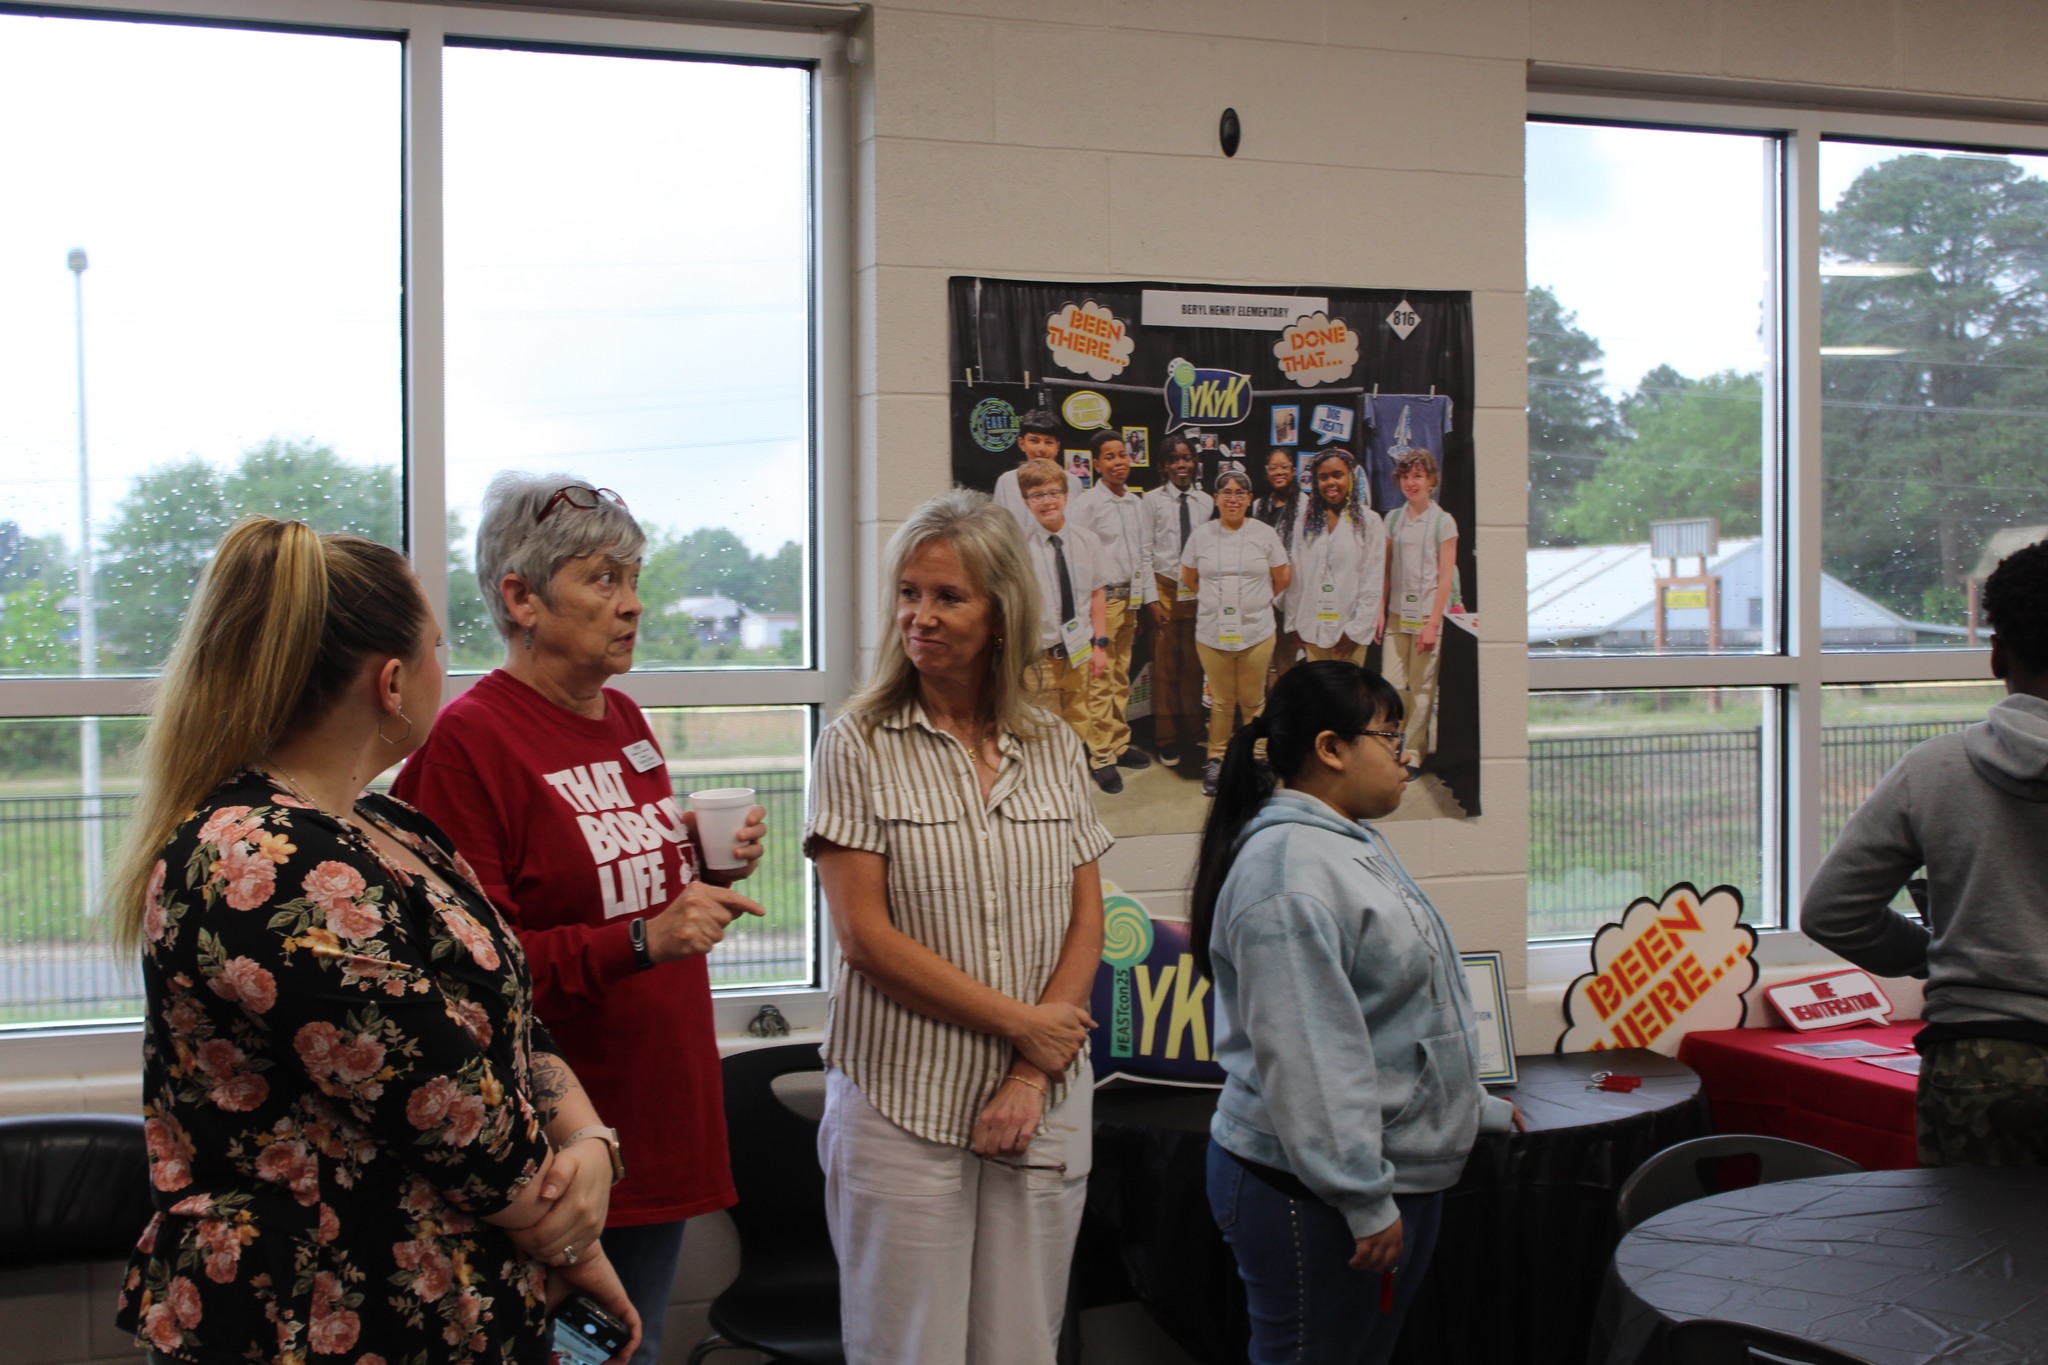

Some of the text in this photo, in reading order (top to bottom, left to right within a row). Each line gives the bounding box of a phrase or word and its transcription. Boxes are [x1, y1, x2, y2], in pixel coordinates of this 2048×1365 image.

[1069, 310, 1123, 342] BEEN
[1181, 304, 1289, 318] BERYL HENRY ELEMENTARY
[1393, 310, 1416, 326] 816
[1047, 325, 1127, 367] THERE...
[1290, 326, 1346, 351] DONE
[1282, 351, 1343, 373] THAT...
[543, 761, 635, 813] THAT
[576, 796, 690, 865] BOBCA
[597, 851, 667, 919] LIFE
[1584, 895, 1706, 1022] BEEN
[1116, 969, 1130, 1053] #EASTcon25
